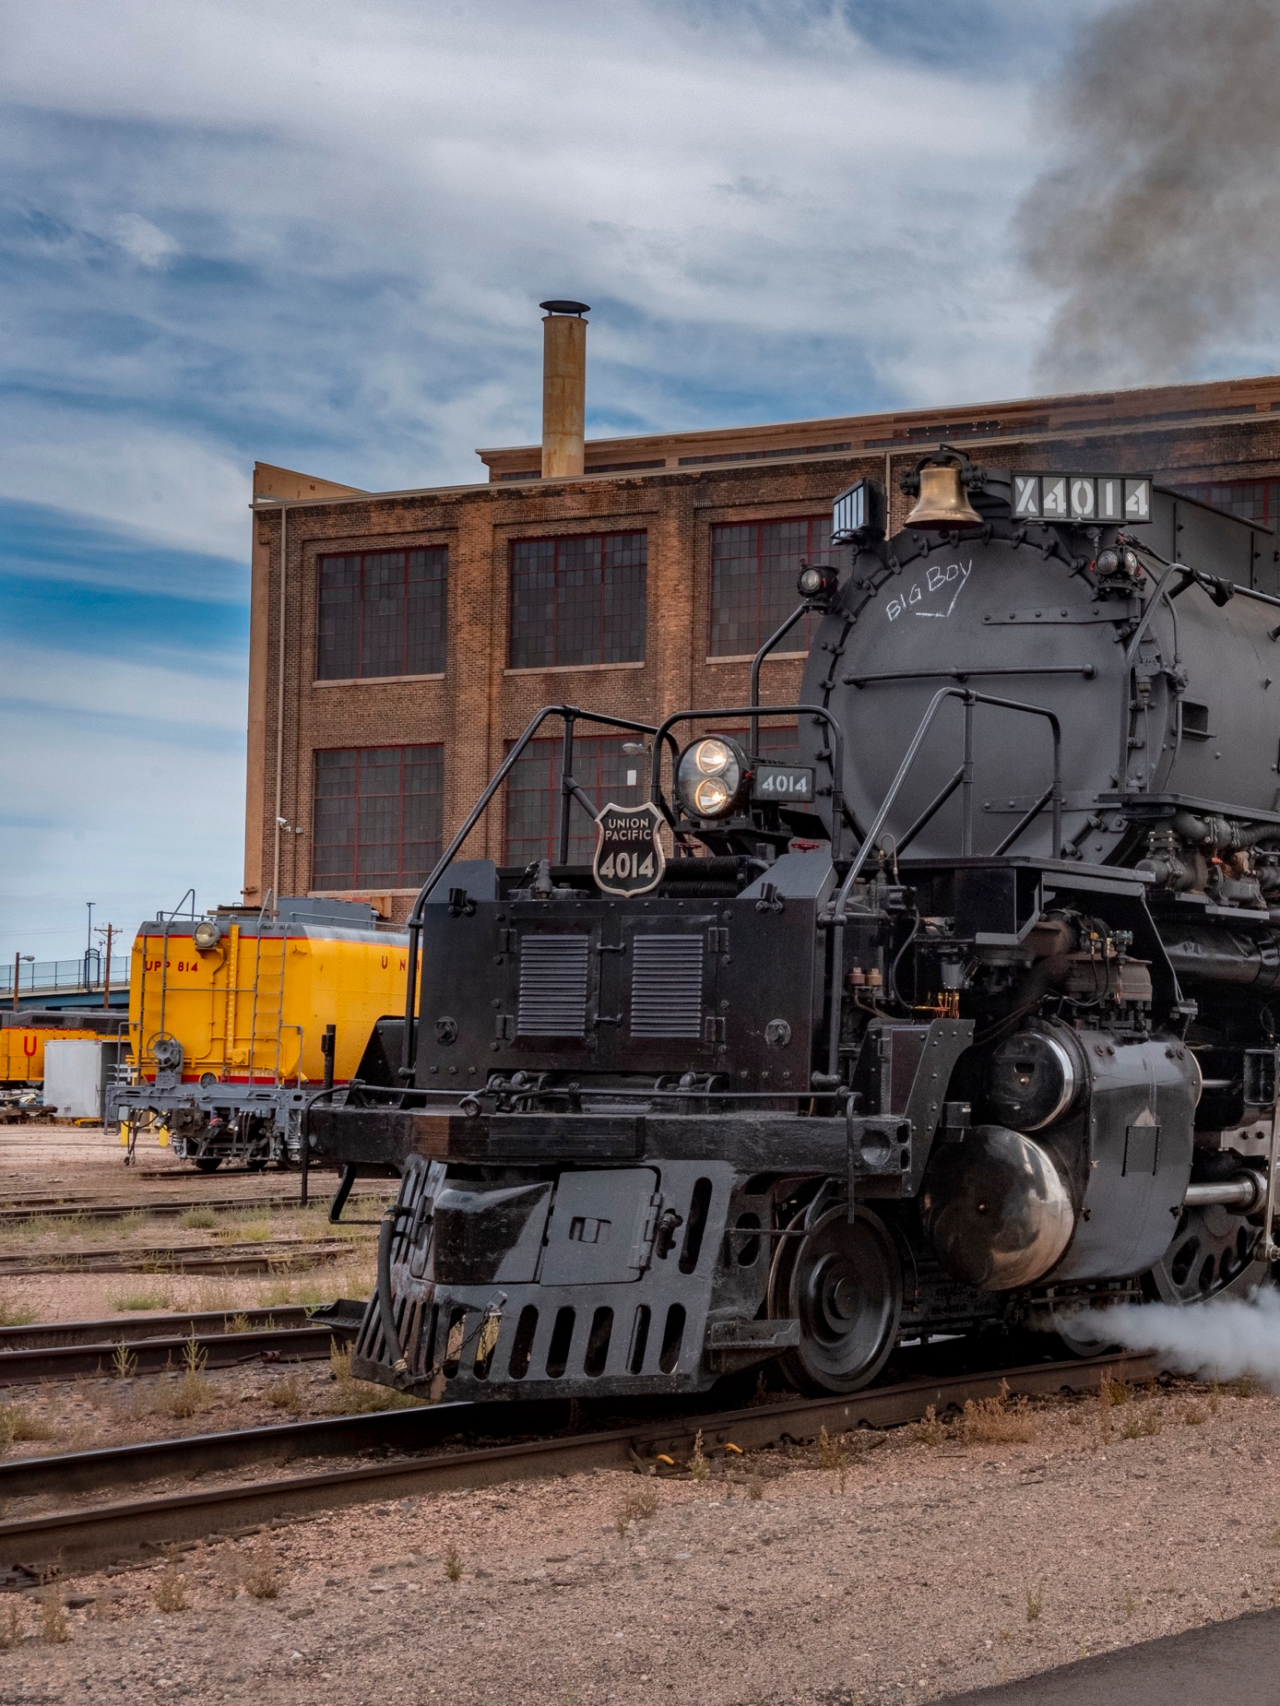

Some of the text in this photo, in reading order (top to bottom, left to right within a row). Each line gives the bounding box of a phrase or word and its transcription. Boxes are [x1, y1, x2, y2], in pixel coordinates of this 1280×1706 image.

[1015, 477, 1149, 516] X4014
[886, 584, 922, 621] BIG
[762, 775, 807, 792] 4014
[608, 818, 649, 829] UNION
[605, 829, 652, 840] PACIFIC
[600, 851, 655, 879] 4014
[177, 962, 198, 972] 814
